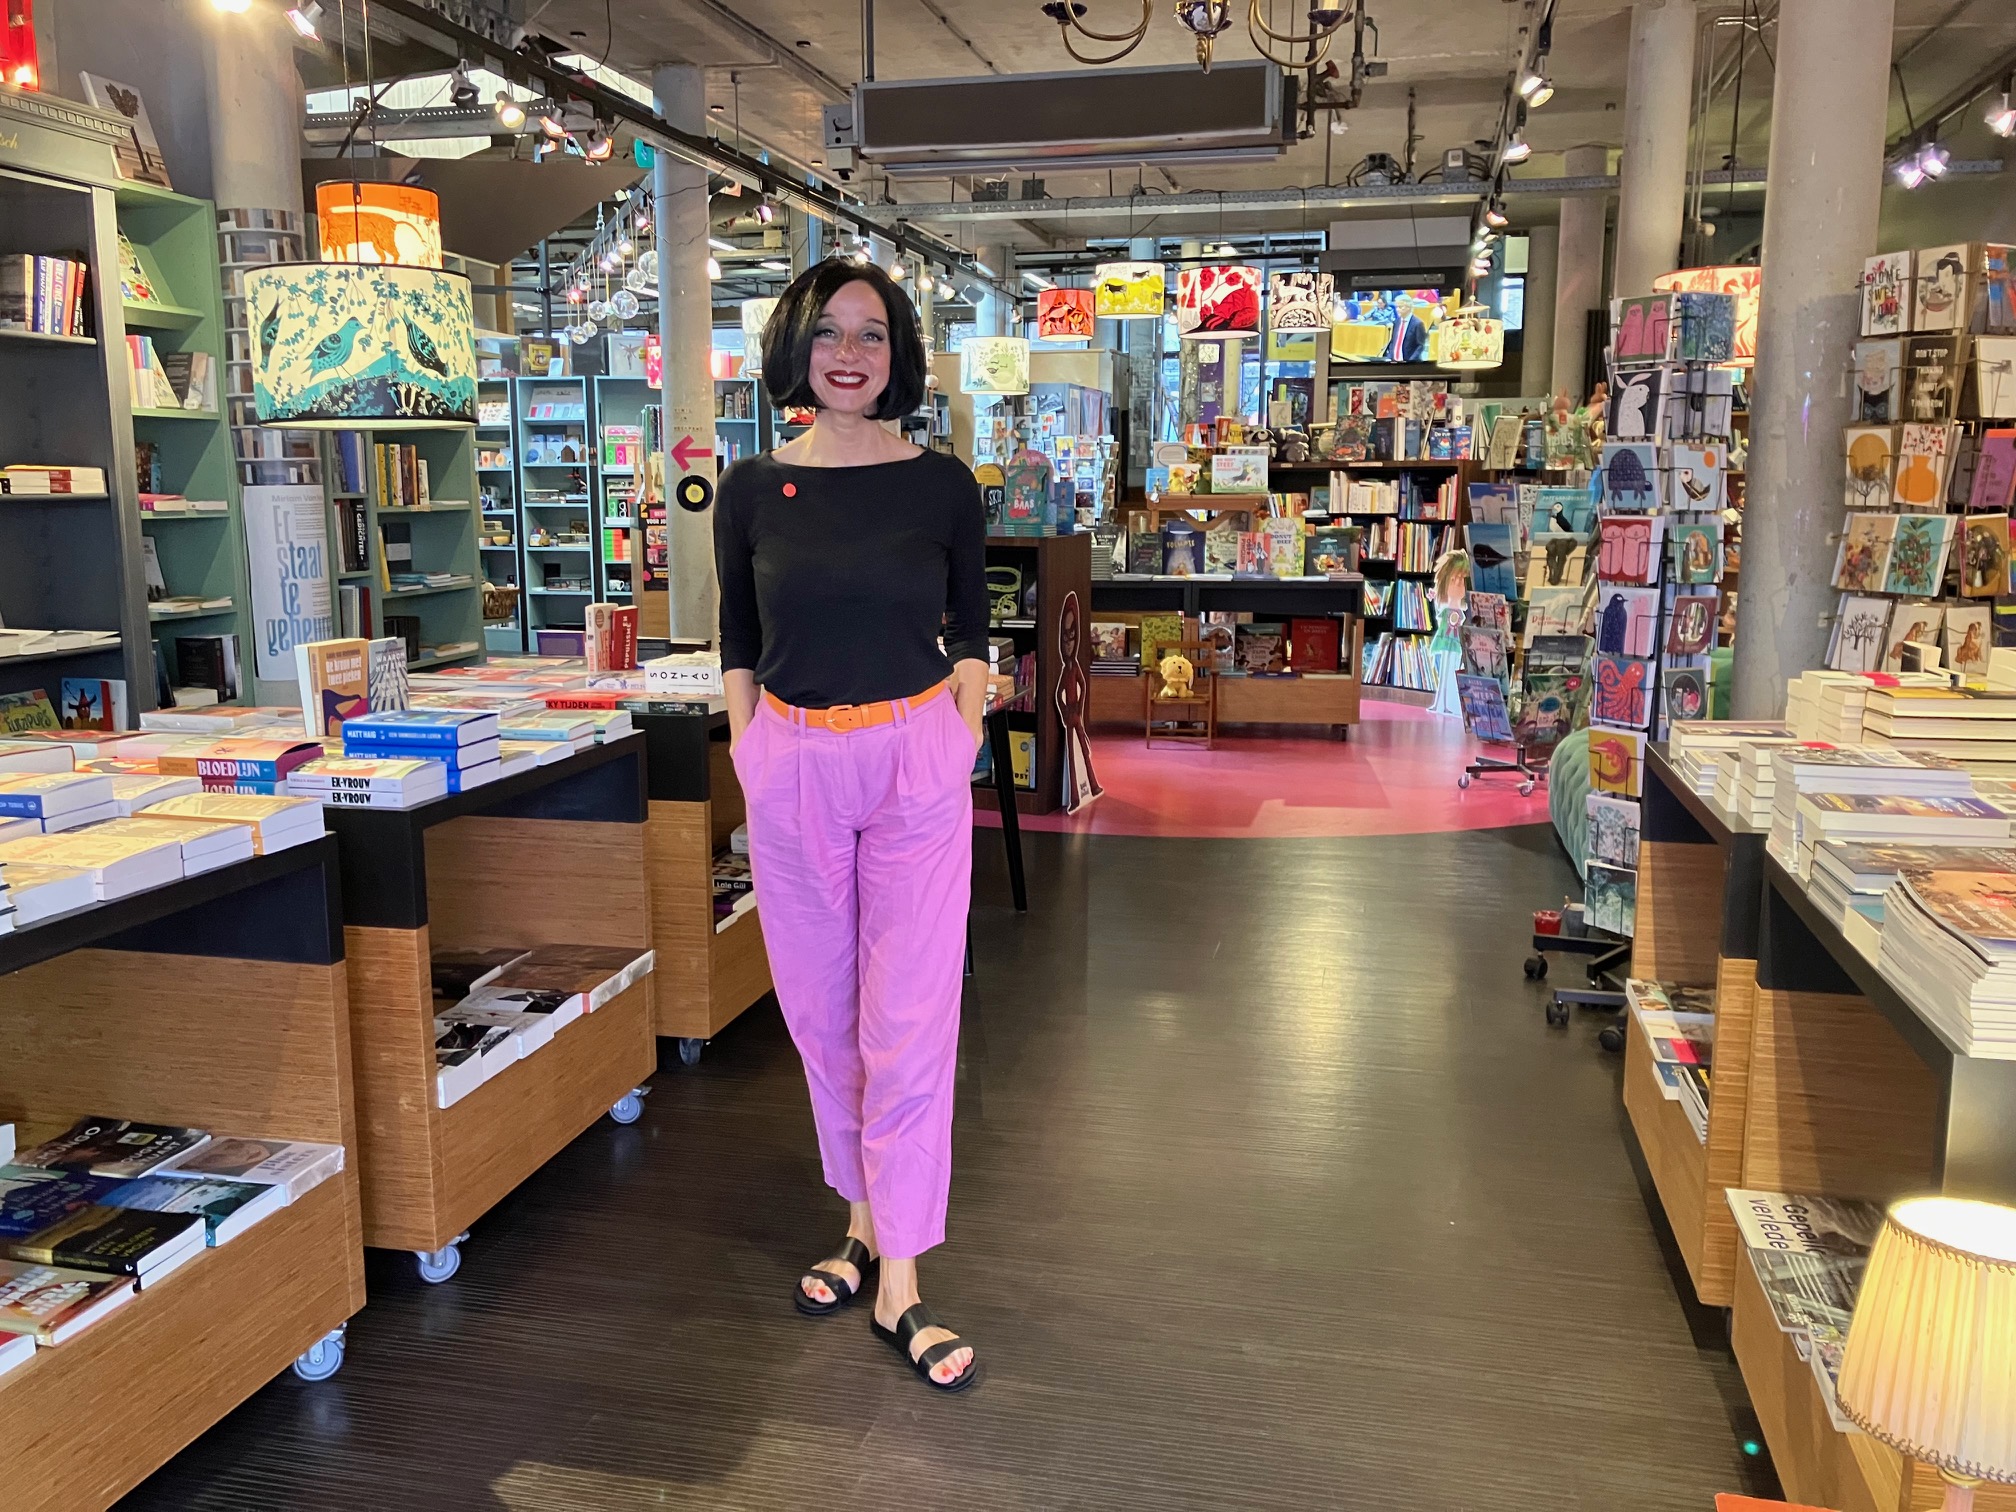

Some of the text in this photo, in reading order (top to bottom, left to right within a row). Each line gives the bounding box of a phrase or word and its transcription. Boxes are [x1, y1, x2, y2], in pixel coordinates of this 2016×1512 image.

[1933, 349, 1948, 357] STOP
[1013, 499, 1035, 510] BAAS
[272, 505, 291, 545] Er
[278, 540, 324, 583] staat
[280, 579, 301, 616] te
[624, 622, 632, 669] POPULISME
[649, 671, 710, 681] SONTAG
[561, 701, 589, 709] TIJDEN
[347, 730, 363, 739] MATT
[363, 731, 377, 739] HAIG
[331, 777, 371, 789] EX-VROUW
[332, 792, 372, 804] EX-VROUW
[37, 1126, 101, 1160] MUNGO
[120, 1135, 174, 1163] OUGLAS
[1748, 1199, 1795, 1250] verlede
